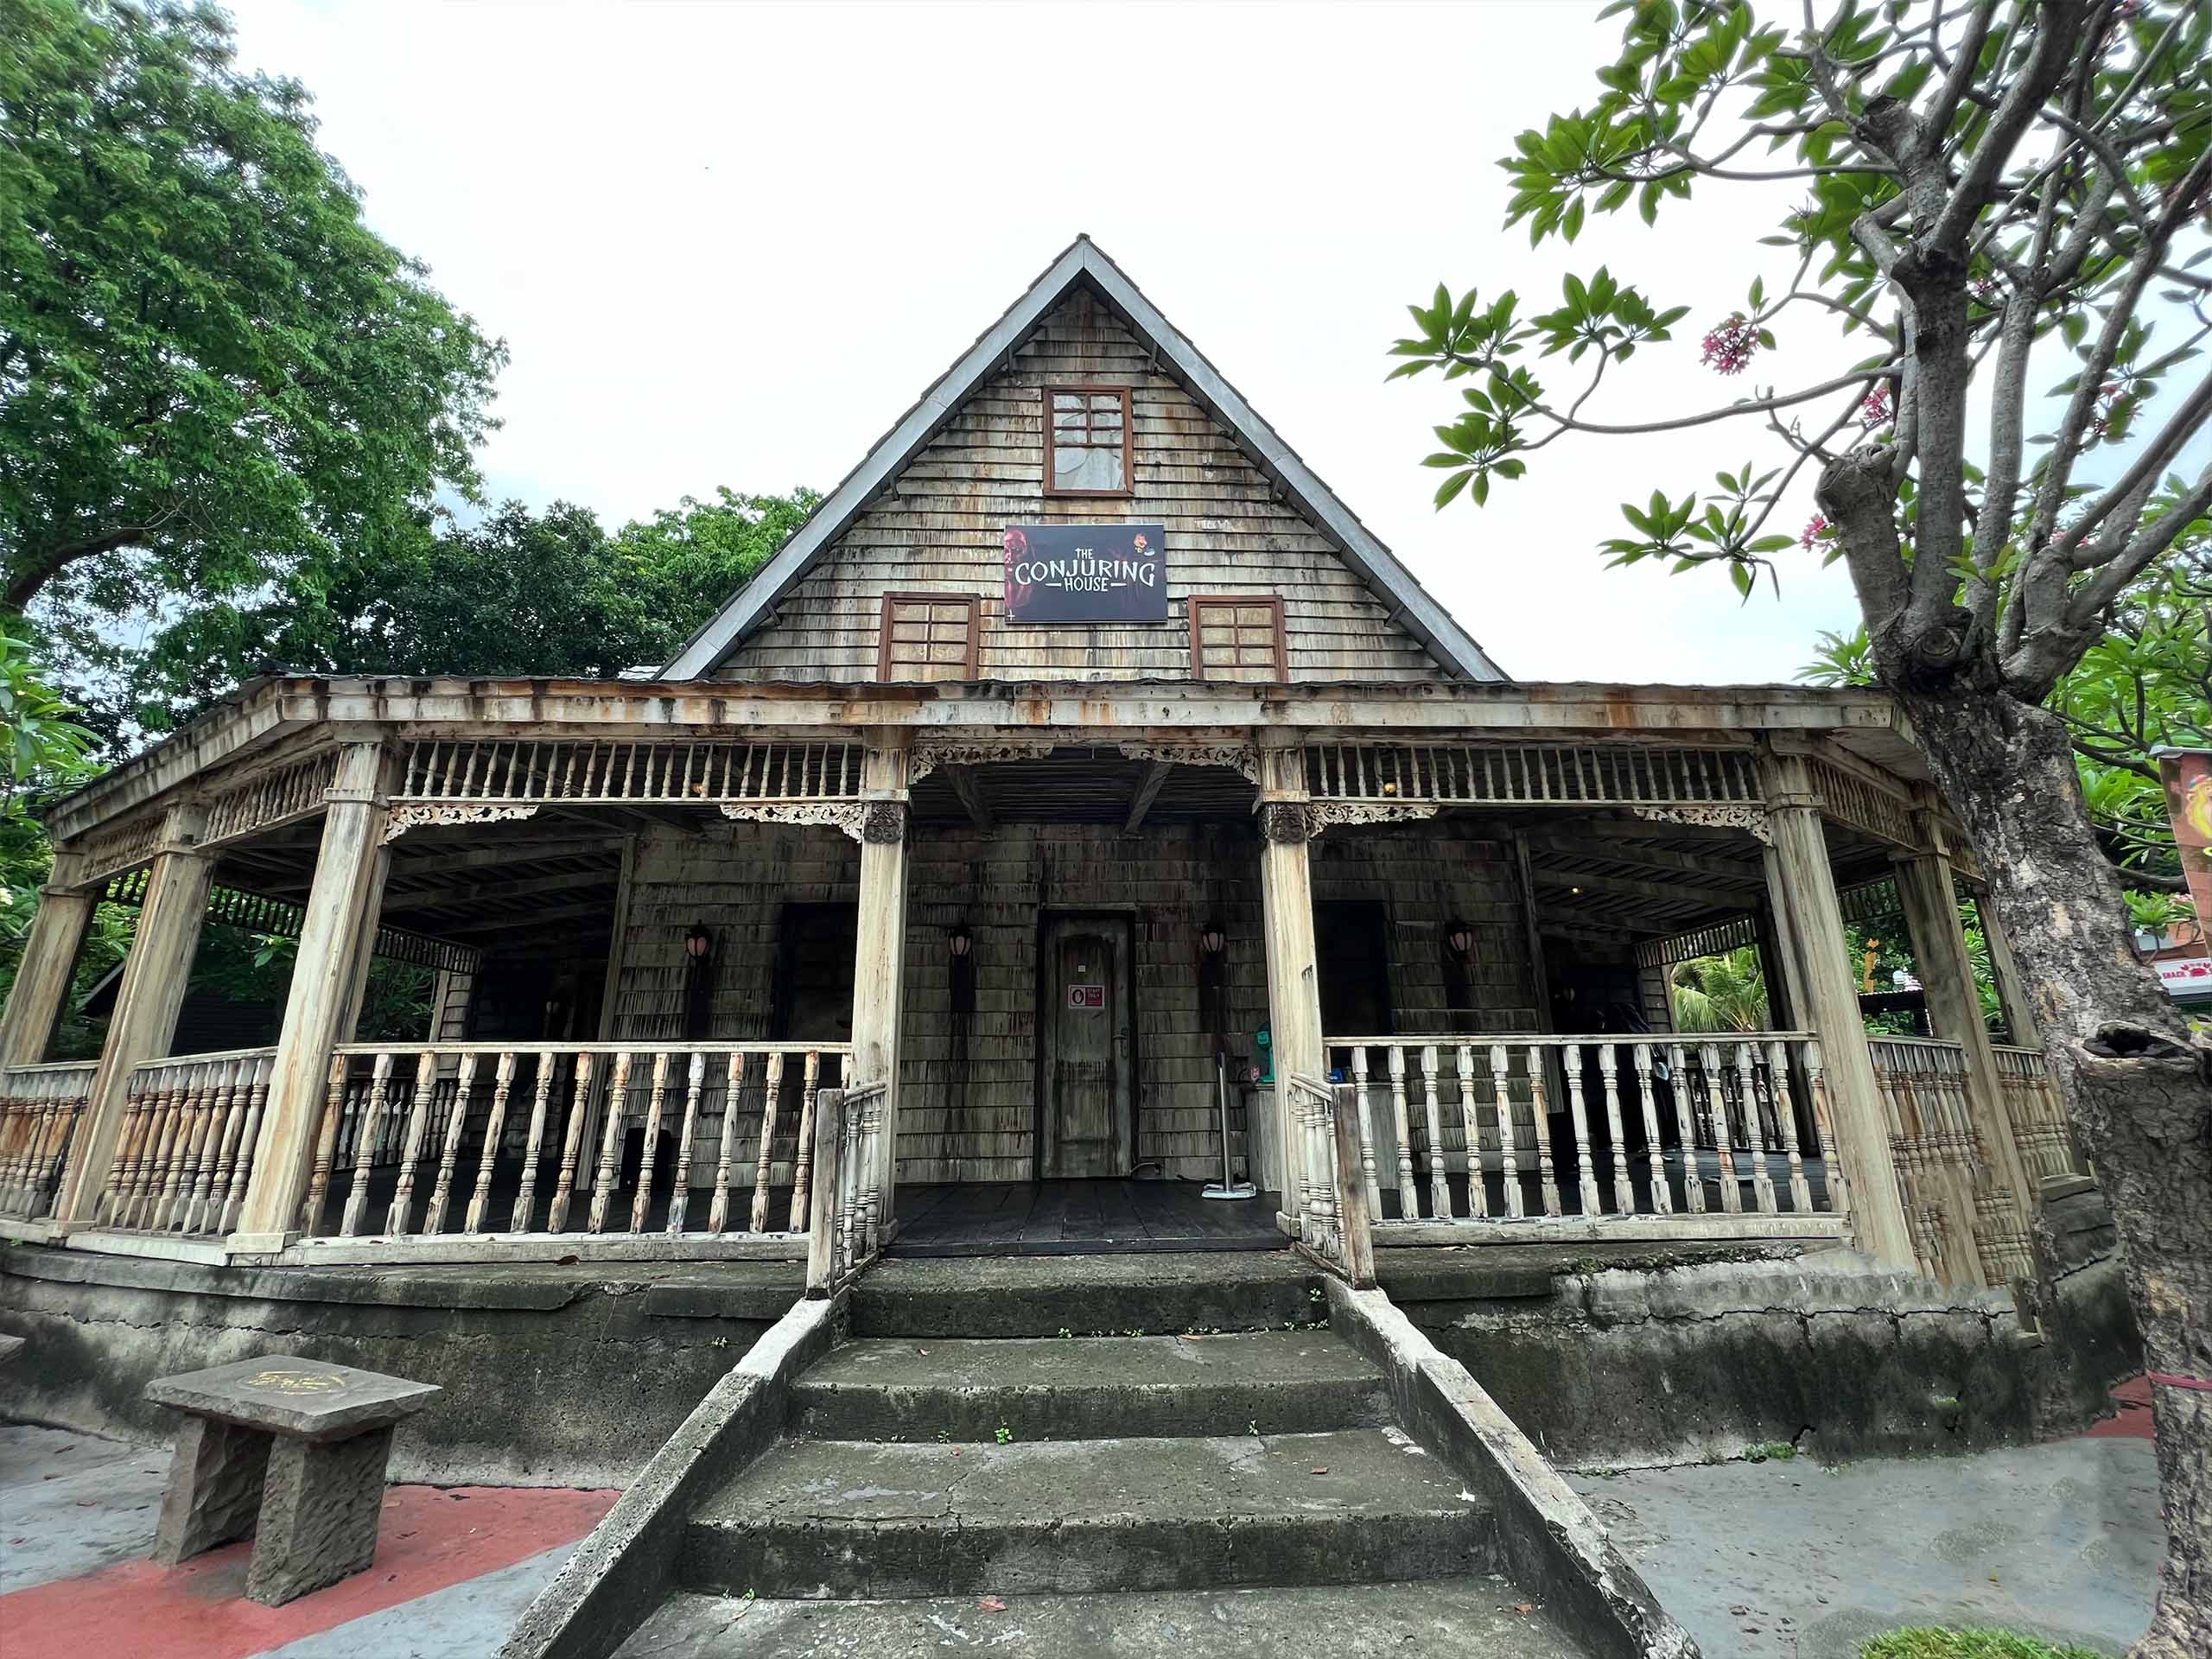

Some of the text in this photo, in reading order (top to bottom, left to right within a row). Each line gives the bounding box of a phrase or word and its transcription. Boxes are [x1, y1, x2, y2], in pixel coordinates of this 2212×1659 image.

[1074, 548, 1093, 560] THE
[1014, 560, 1155, 588] CONJURING
[1064, 577, 1109, 592] HOUSE
